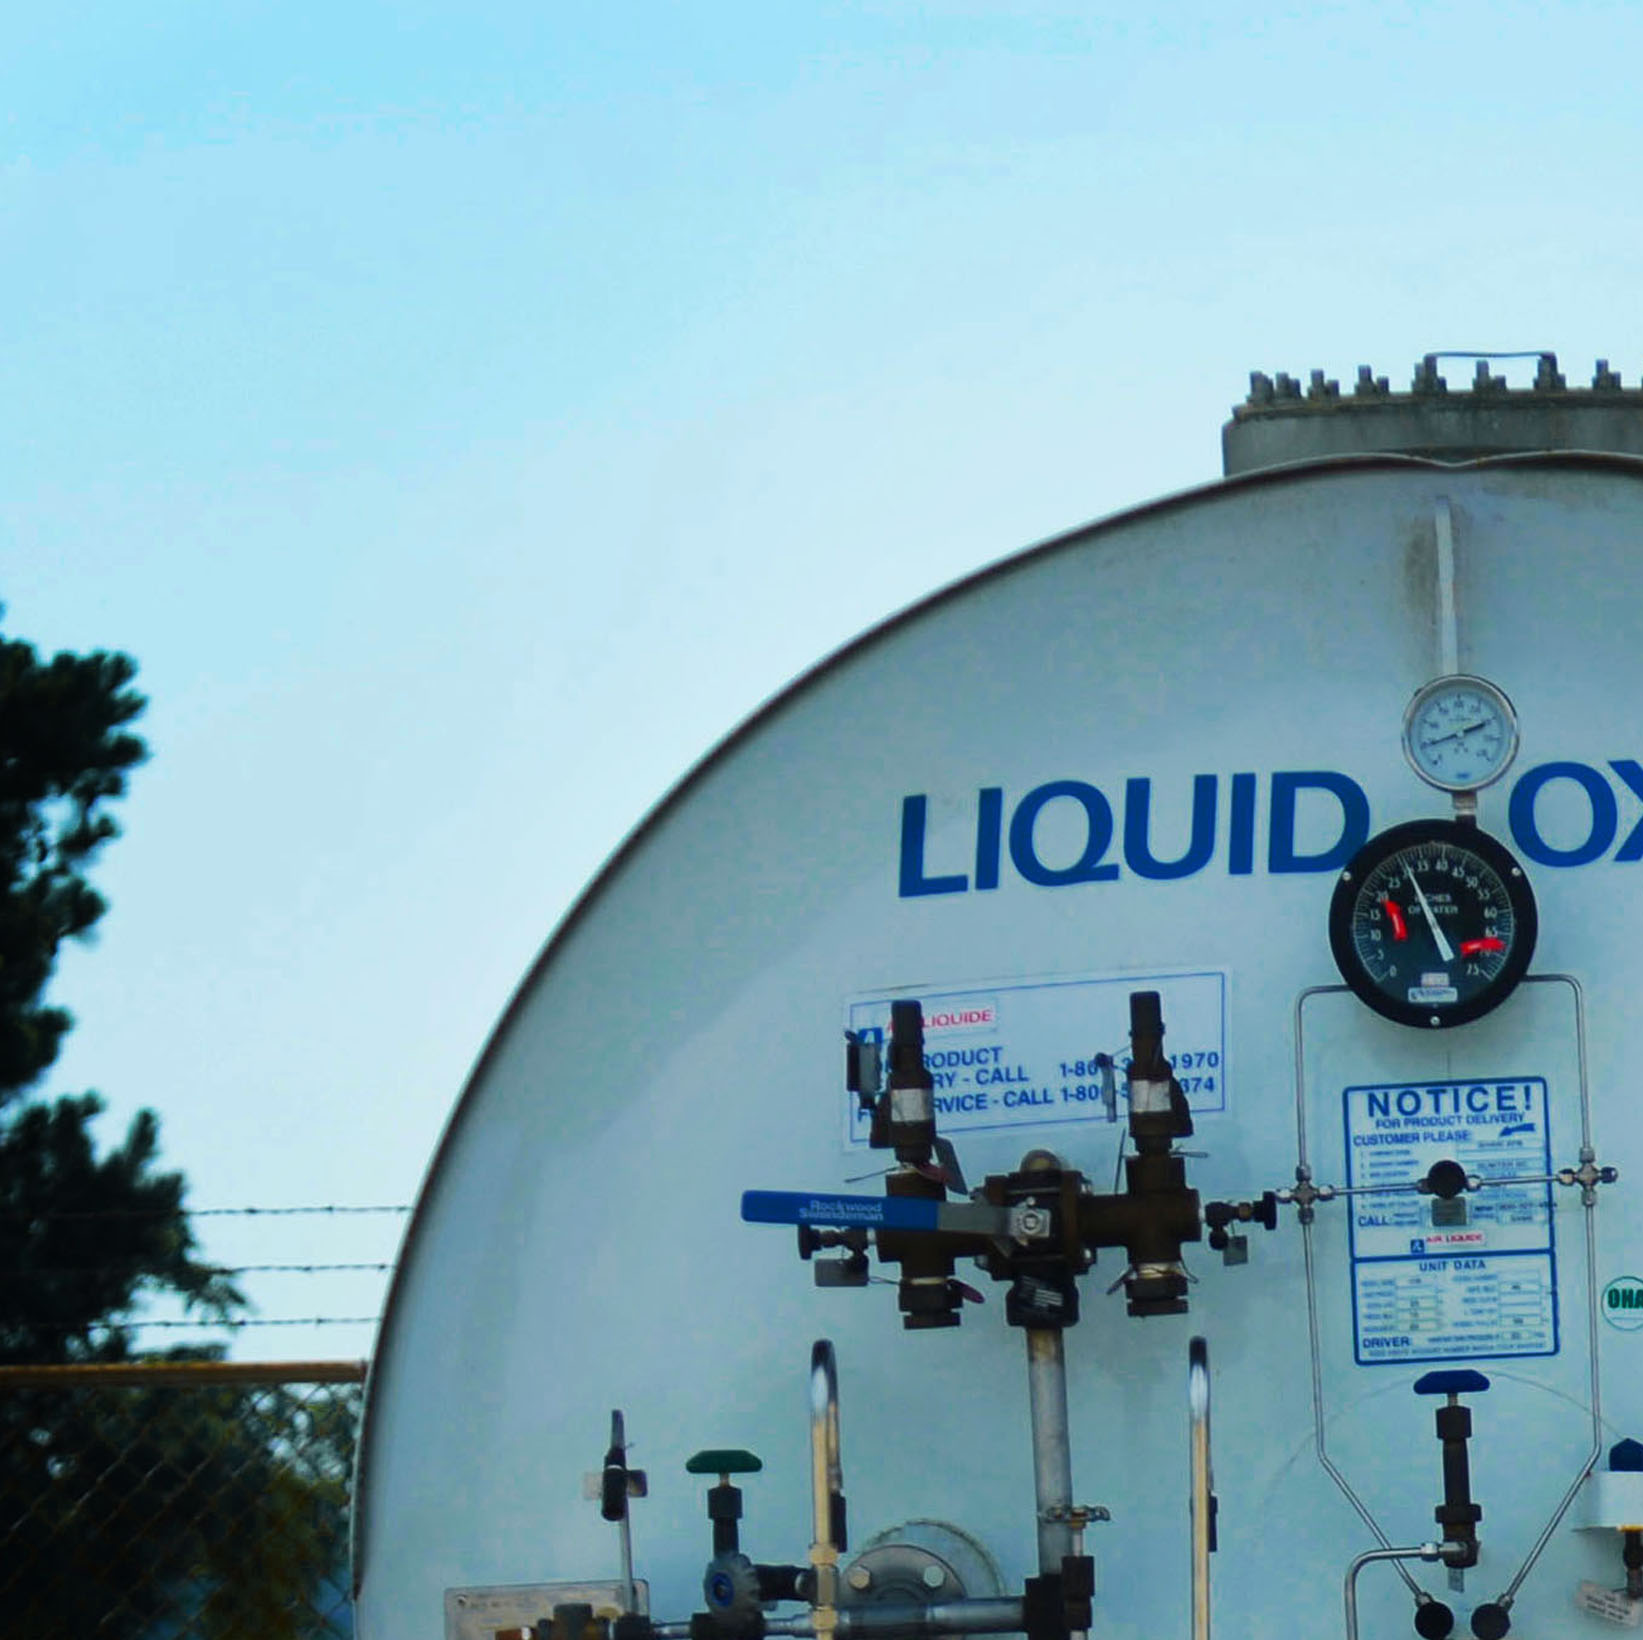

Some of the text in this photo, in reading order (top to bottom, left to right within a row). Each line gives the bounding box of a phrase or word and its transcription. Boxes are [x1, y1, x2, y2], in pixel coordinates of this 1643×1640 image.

[899, 771, 1370, 897] LIQUID
[1484, 907, 1498, 919] 60
[922, 1009, 992, 1028] LIQUIDE
[924, 1046, 1003, 1068] RODUCT
[976, 1066, 1030, 1085] CALL
[934, 1093, 988, 1113] RVICE
[1004, 1088, 1054, 1107] CALL
[1368, 1085, 1532, 1118] NOTICE!
[1376, 1111, 1526, 1129] FOR PRODUCT DELIVERY
[1353, 1132, 1420, 1147] CUSTOMER
[1419, 1260, 1487, 1272] UNIT DATA
